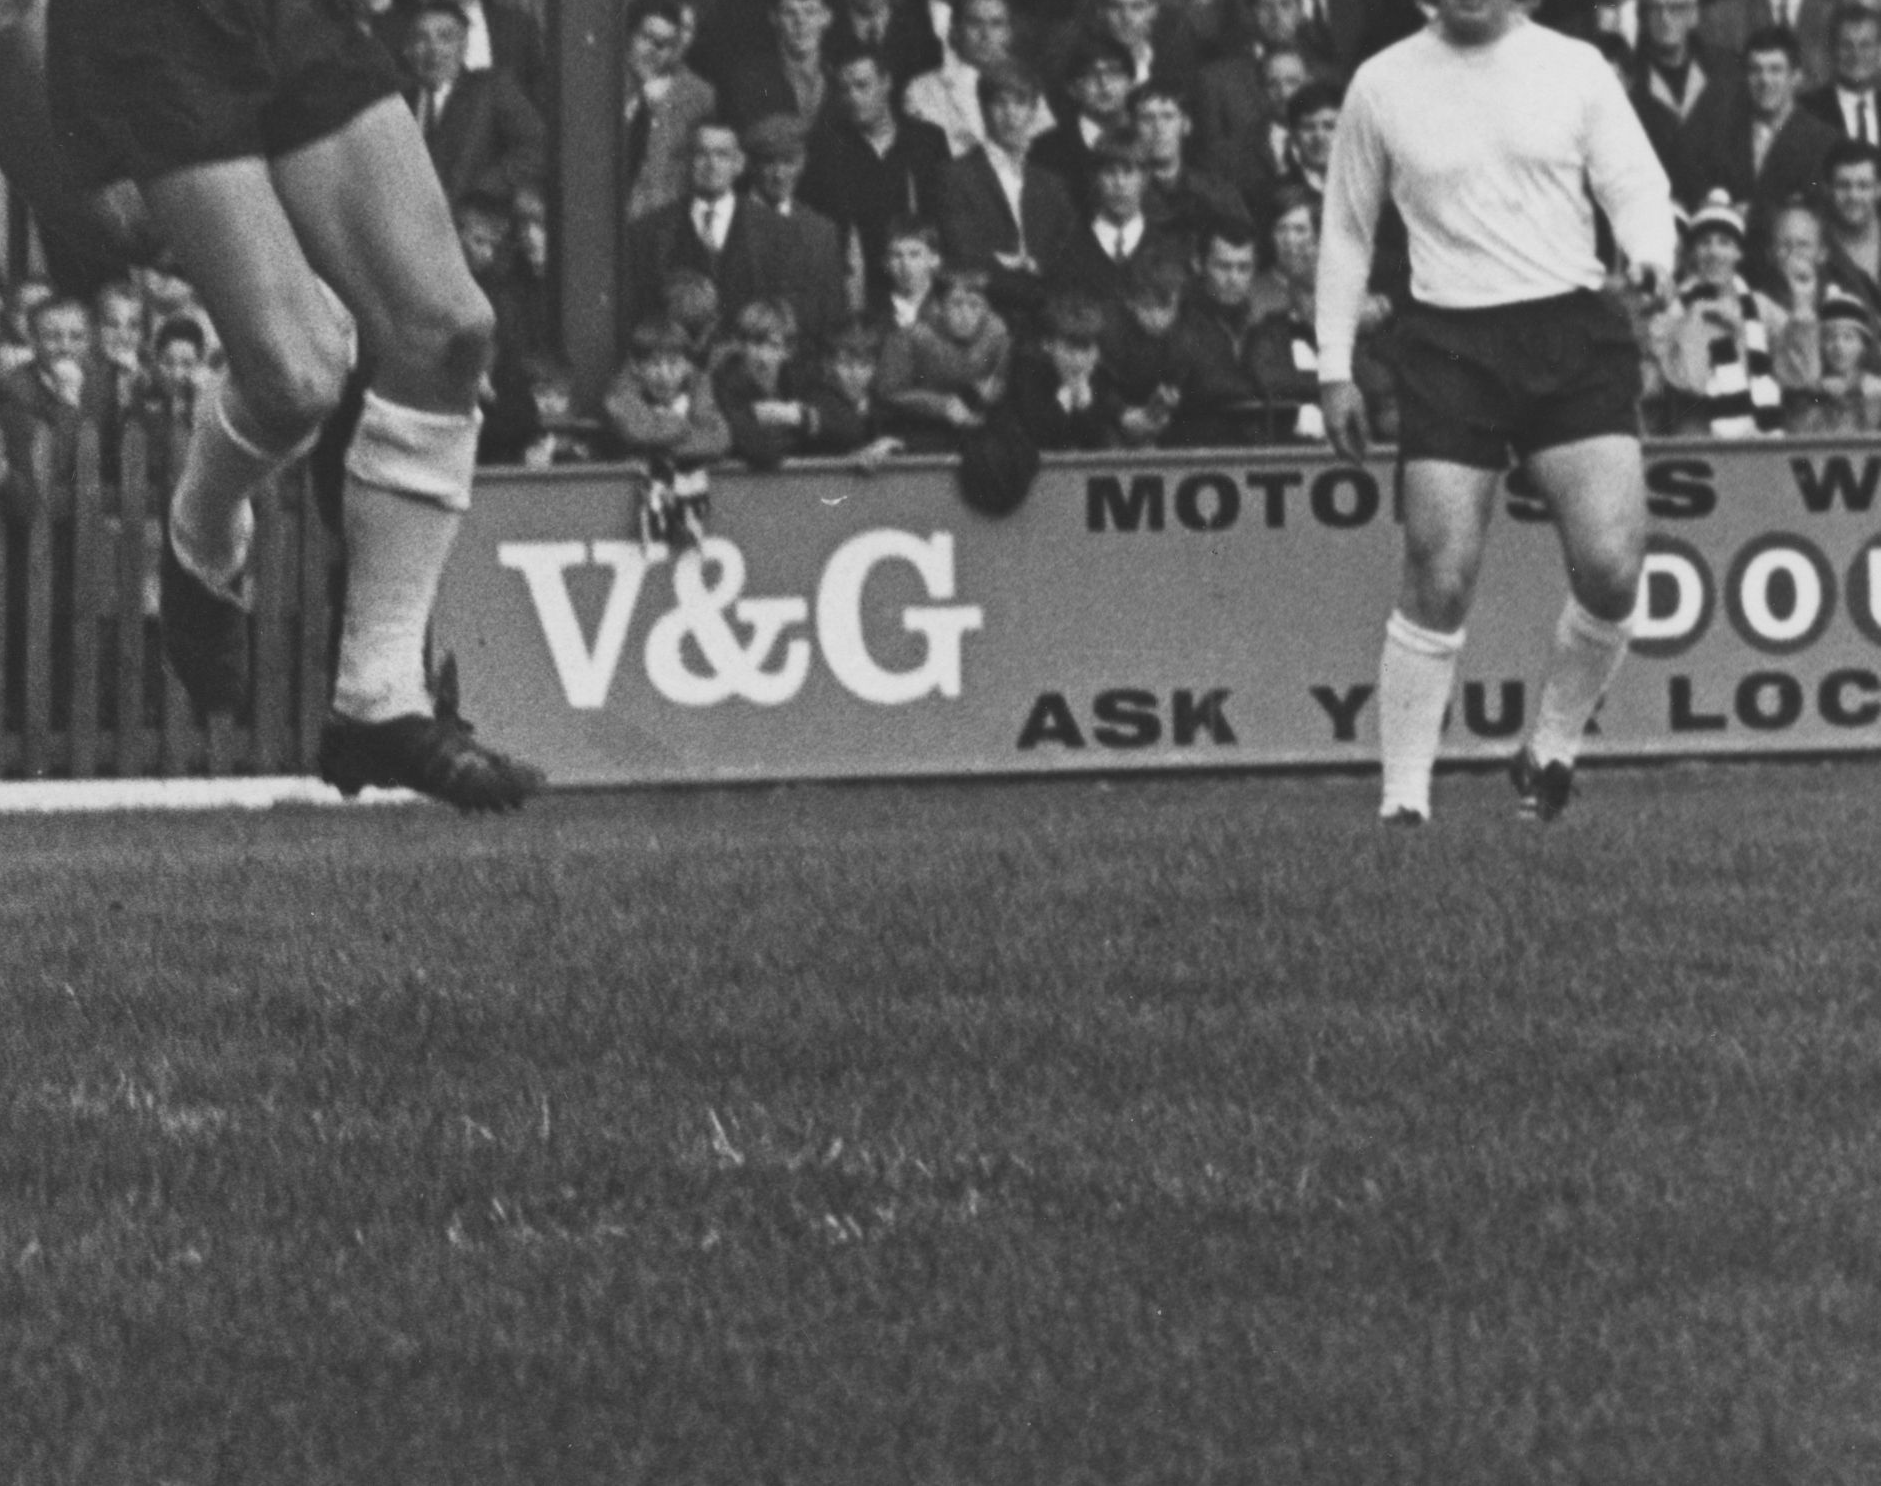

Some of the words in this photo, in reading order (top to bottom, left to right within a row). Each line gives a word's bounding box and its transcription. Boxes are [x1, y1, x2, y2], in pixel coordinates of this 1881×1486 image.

[498, 528, 983, 709] V&G
[1630, 546, 1881, 643] DO
[1017, 687, 1237, 750] ASK
[1309, 678, 1605, 743] YU
